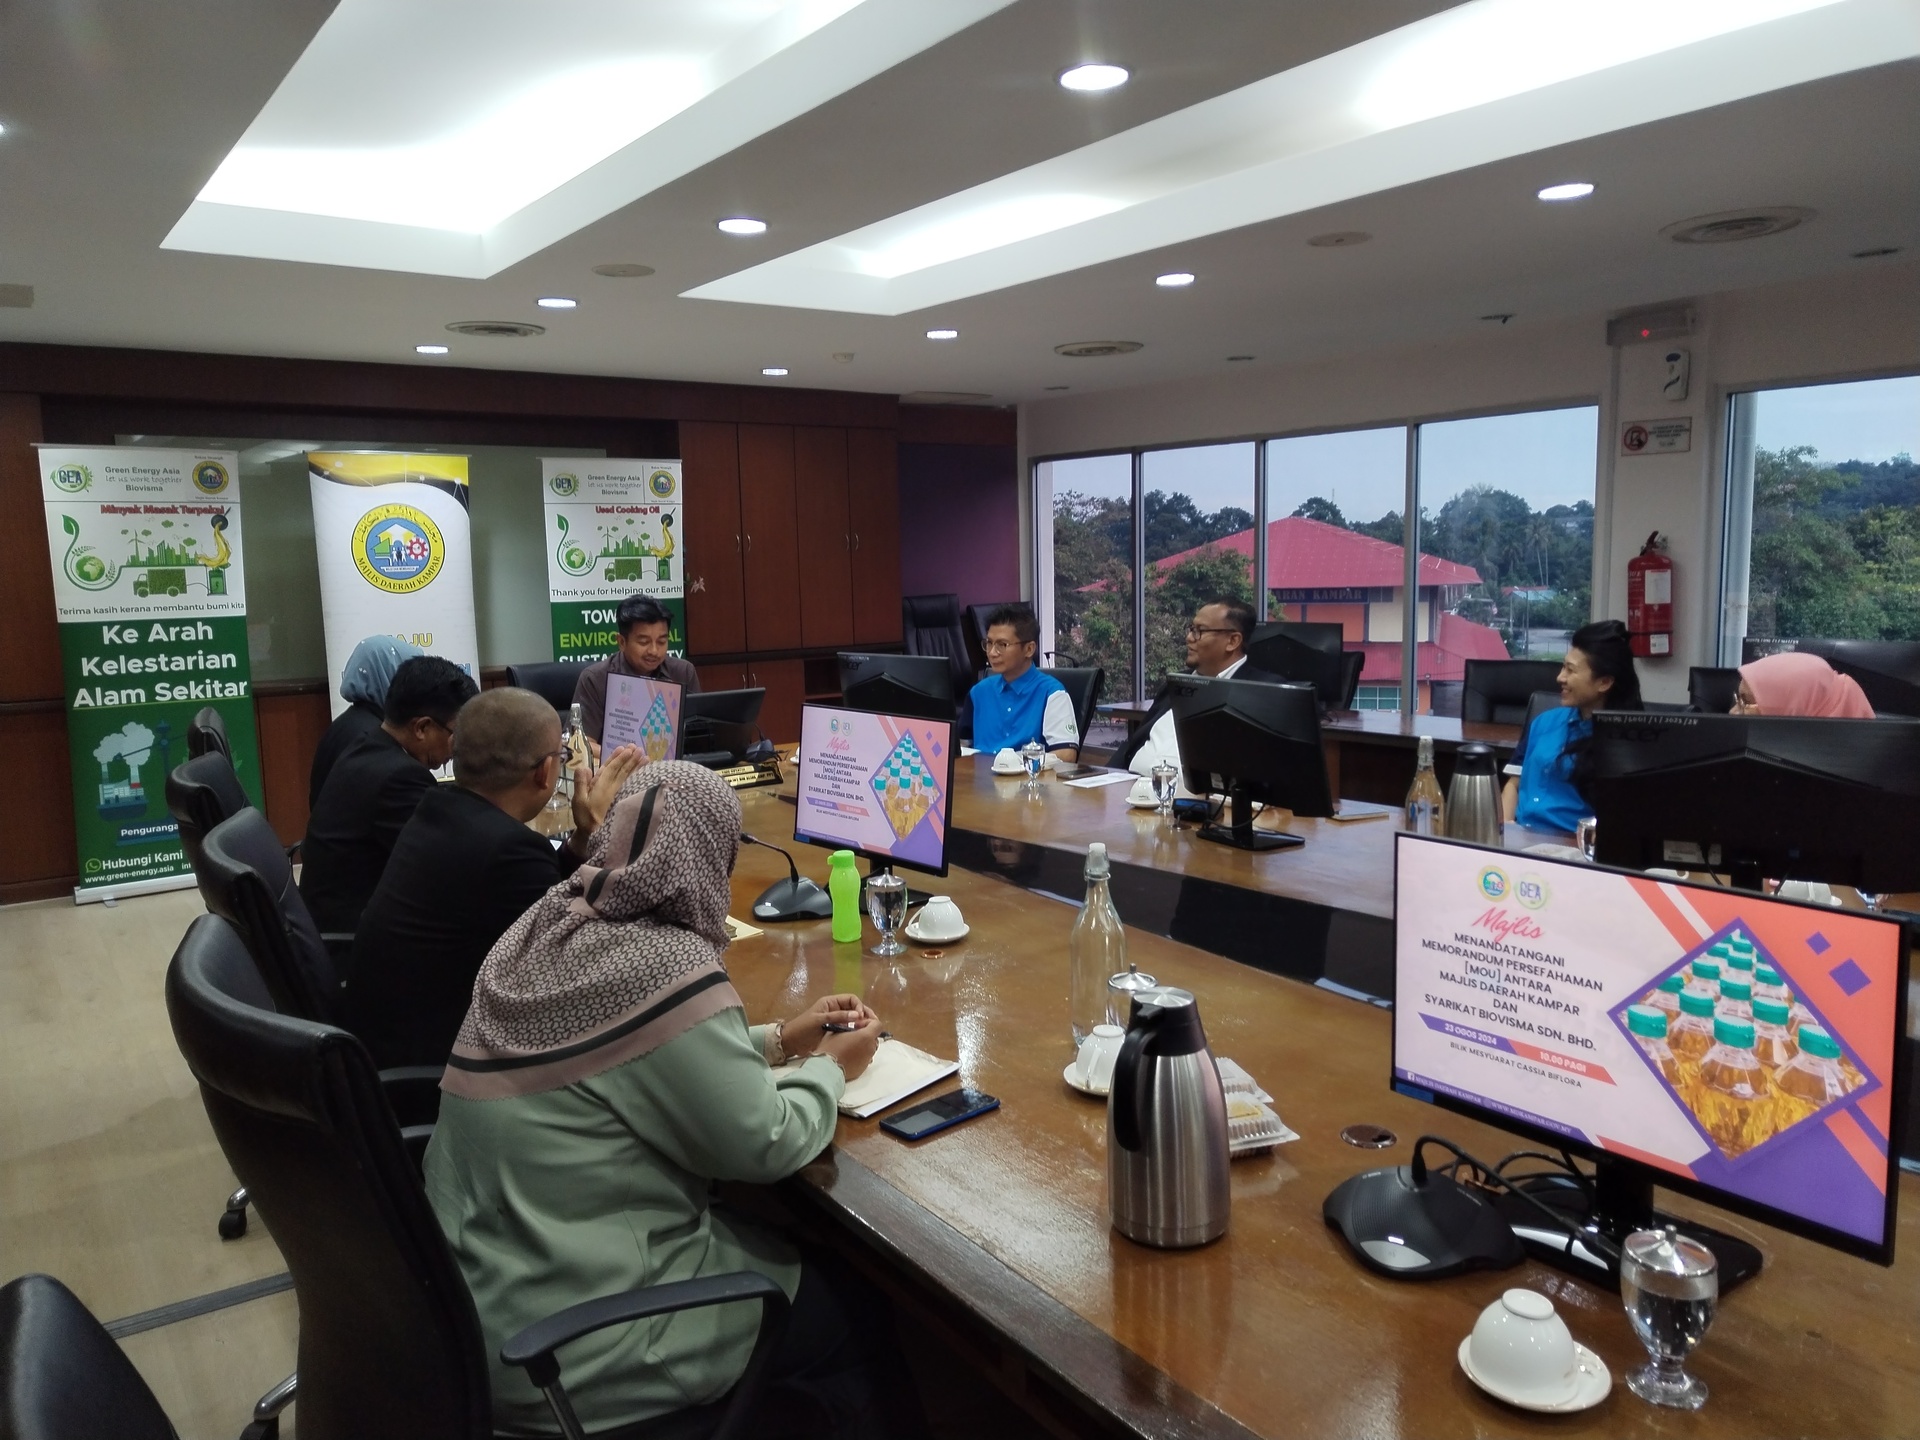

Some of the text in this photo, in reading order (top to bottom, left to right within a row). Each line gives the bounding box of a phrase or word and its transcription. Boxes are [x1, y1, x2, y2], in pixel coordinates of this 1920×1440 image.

[58, 470, 82, 484] GEA
[132, 467, 160, 475] Energy
[152, 476, 182, 485] together
[555, 478, 572, 489] GEA
[100, 504, 224, 516] Minyak Masak Terpakai
[595, 506, 615, 514] Used
[616, 506, 648, 515] Cooking
[357, 556, 441, 590] MAJLIS DAERAH KAMPAR
[551, 588, 579, 597] Thank
[580, 589, 595, 597] you
[610, 586, 644, 596] Helping
[661, 585, 682, 594] Earth!
[1313, 589, 1362, 600] KAMPAR
[58, 601, 244, 616] Terima kasih kerana membantu bumi kita
[102, 621, 213, 645] Ke Arah
[81, 650, 237, 677] Kelestarian
[73, 679, 248, 708] Alam Sekitar
[1174, 685, 1198, 697] acer
[808, 757, 836, 767] MEMORANDUM
[120, 823, 179, 837] Penguranga
[102, 849, 183, 870] Hubungi Kami
[85, 864, 174, 884] www.green-energy.asia
[1520, 881, 1541, 900] GEA
[1472, 907, 1544, 942] Majlis
[1454, 932, 1565, 967] MENANDATANGANI
[1422, 939, 1603, 991] MEMORANDUM PERSEFAHAMAN
[1465, 961, 1552, 994] [MOU] ANTARA
[1439, 970, 1580, 1016] MAJLIS DAERAH KAMPAR
[1493, 999, 1518, 1013] DAN
[1425, 994, 1597, 1051] SYARIKAT BIOVISMA SDN. BHD.
[1444, 1023, 1497, 1045] 23 OGOS 2024
[1450, 1041, 1582, 1088] BILIK MESYUARAT CASSIA BIFLORA
[1540, 1051, 1587, 1073] 10.00 PAGI
